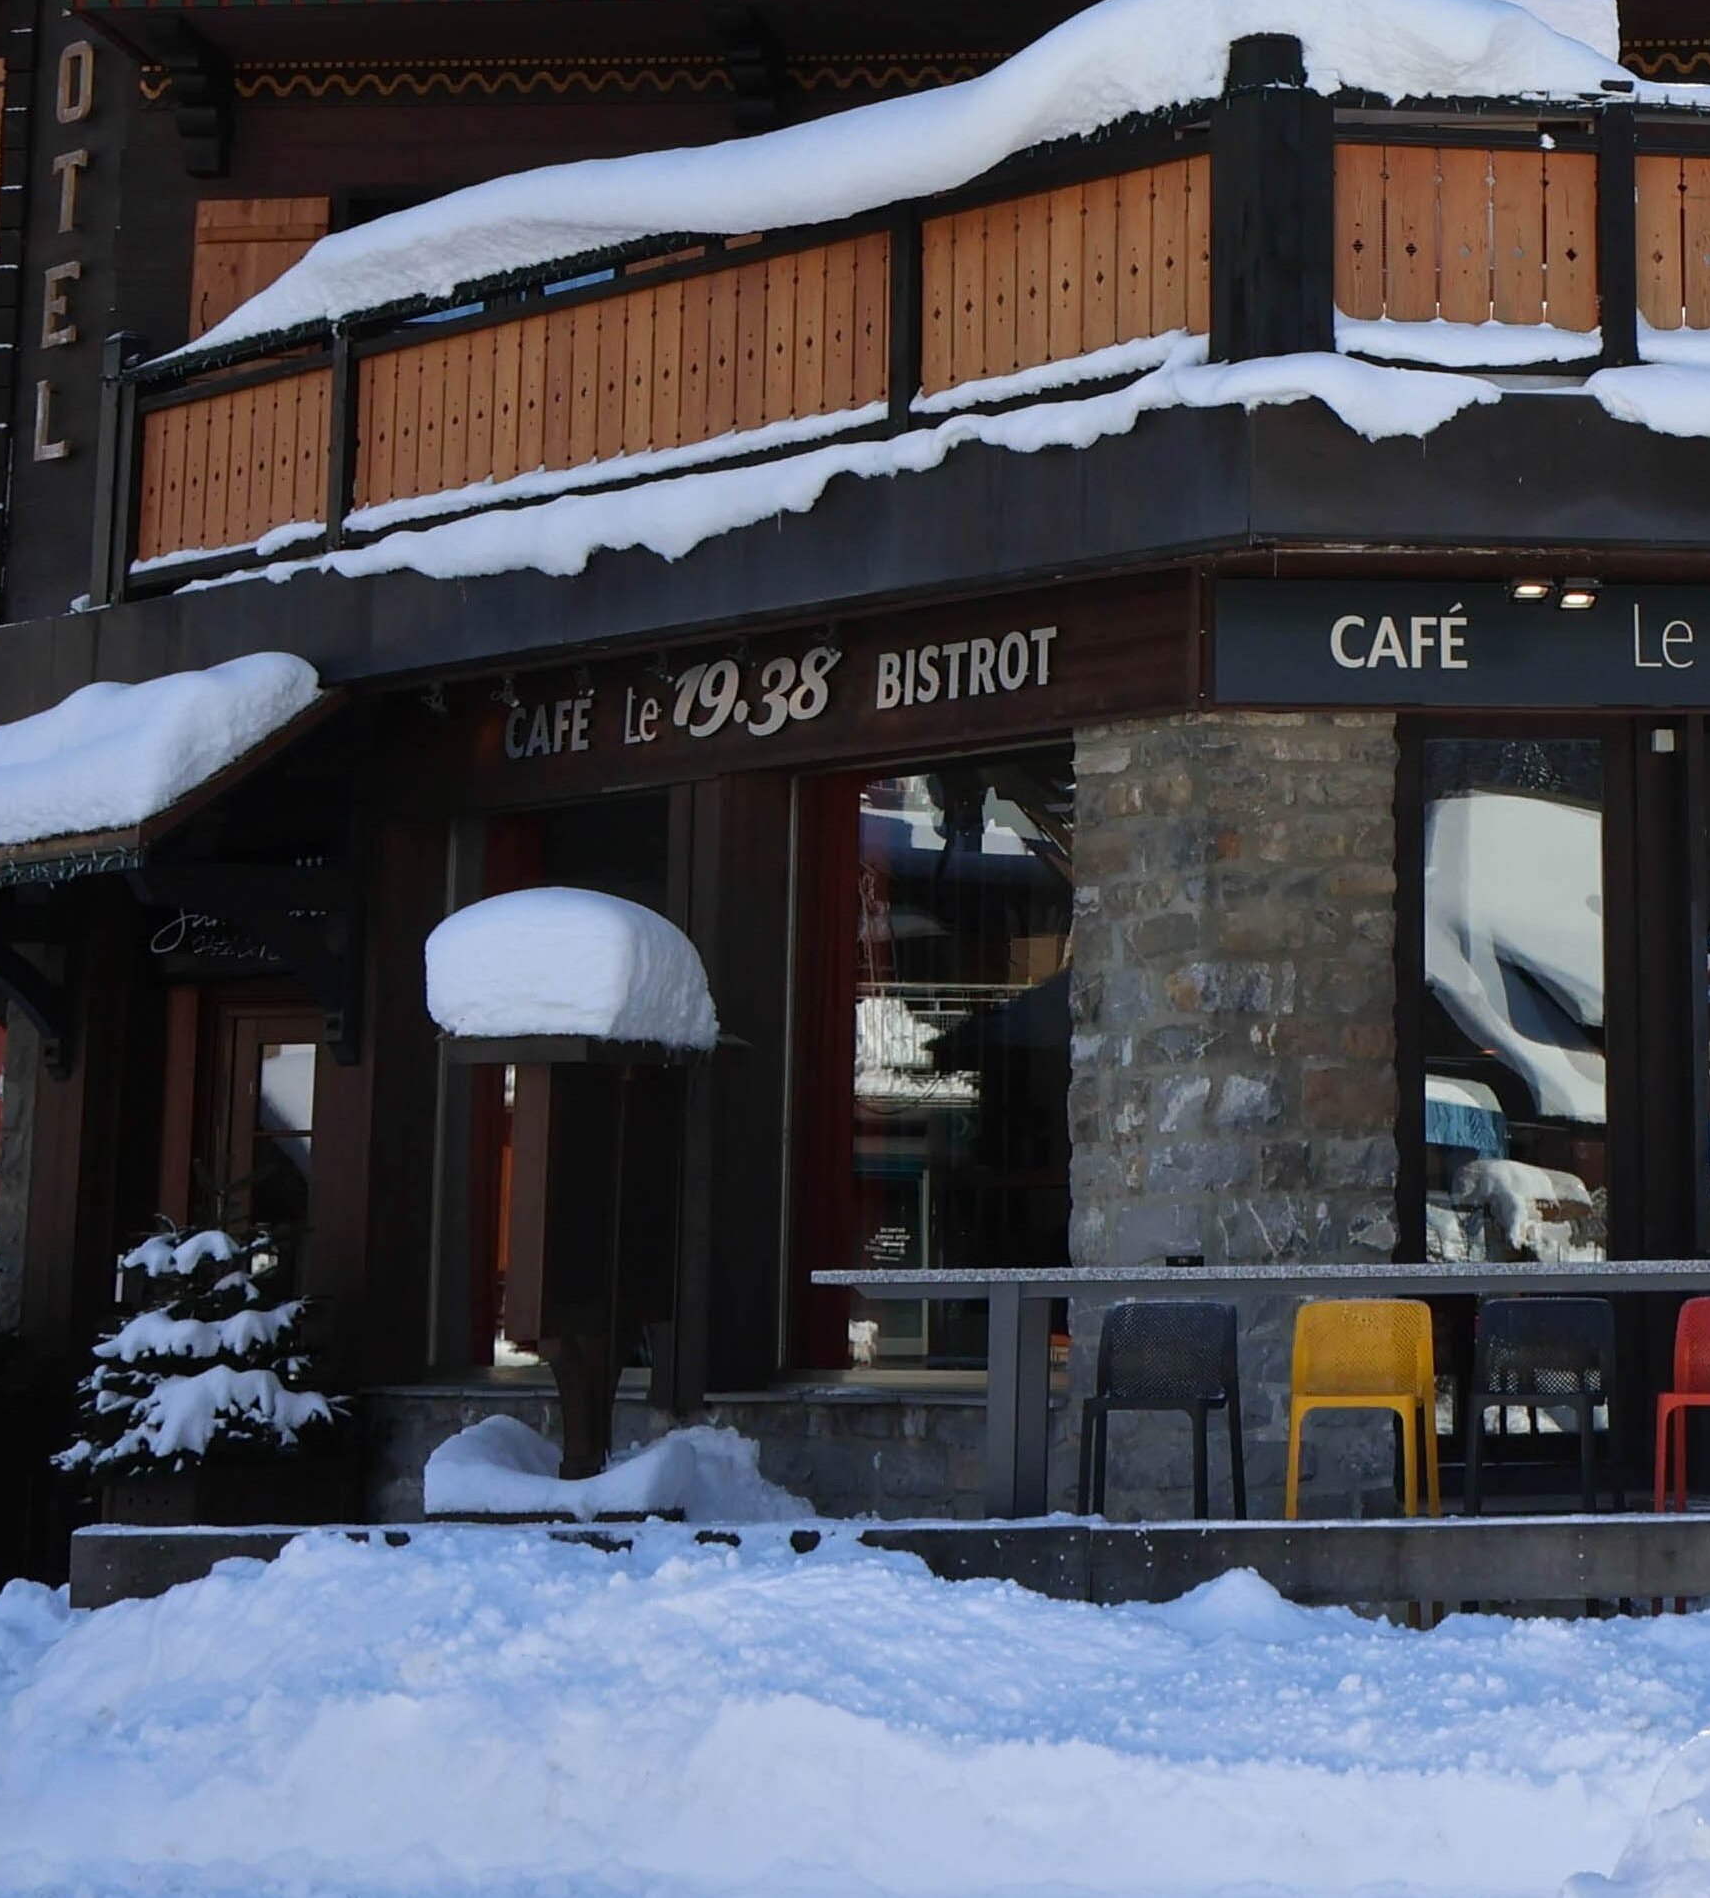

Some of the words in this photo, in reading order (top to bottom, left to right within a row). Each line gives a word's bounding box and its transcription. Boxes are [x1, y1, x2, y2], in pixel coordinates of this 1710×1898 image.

[1330, 602, 1469, 669] CAFÉ
[1633, 603, 1695, 669] Le
[623, 686, 662, 745] Le
[673, 646, 843, 739] 19.38
[875, 625, 1058, 711] BISTROT
